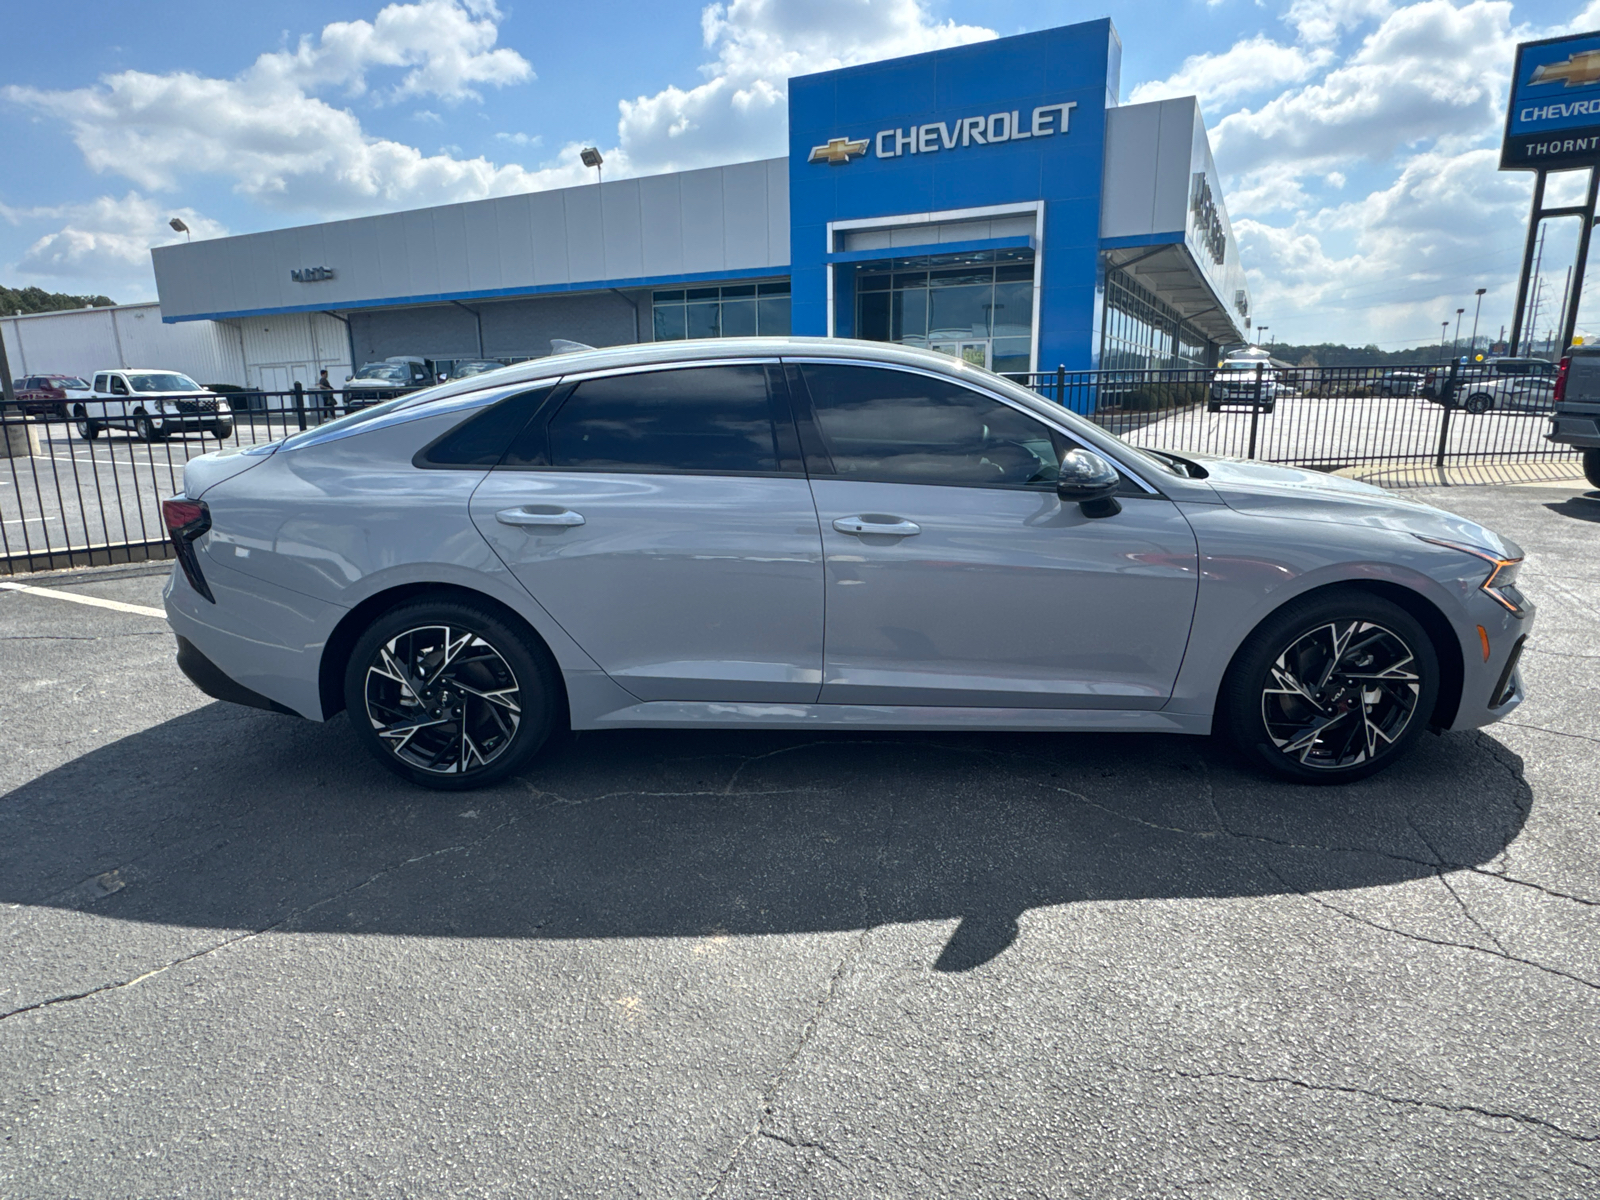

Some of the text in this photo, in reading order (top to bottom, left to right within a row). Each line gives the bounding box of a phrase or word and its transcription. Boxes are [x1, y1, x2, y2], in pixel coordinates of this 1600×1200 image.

[1520, 99, 1600, 121] CHEVRO
[875, 101, 1078, 159] CHEVROLET
[1525, 136, 1600, 156] THORNT
